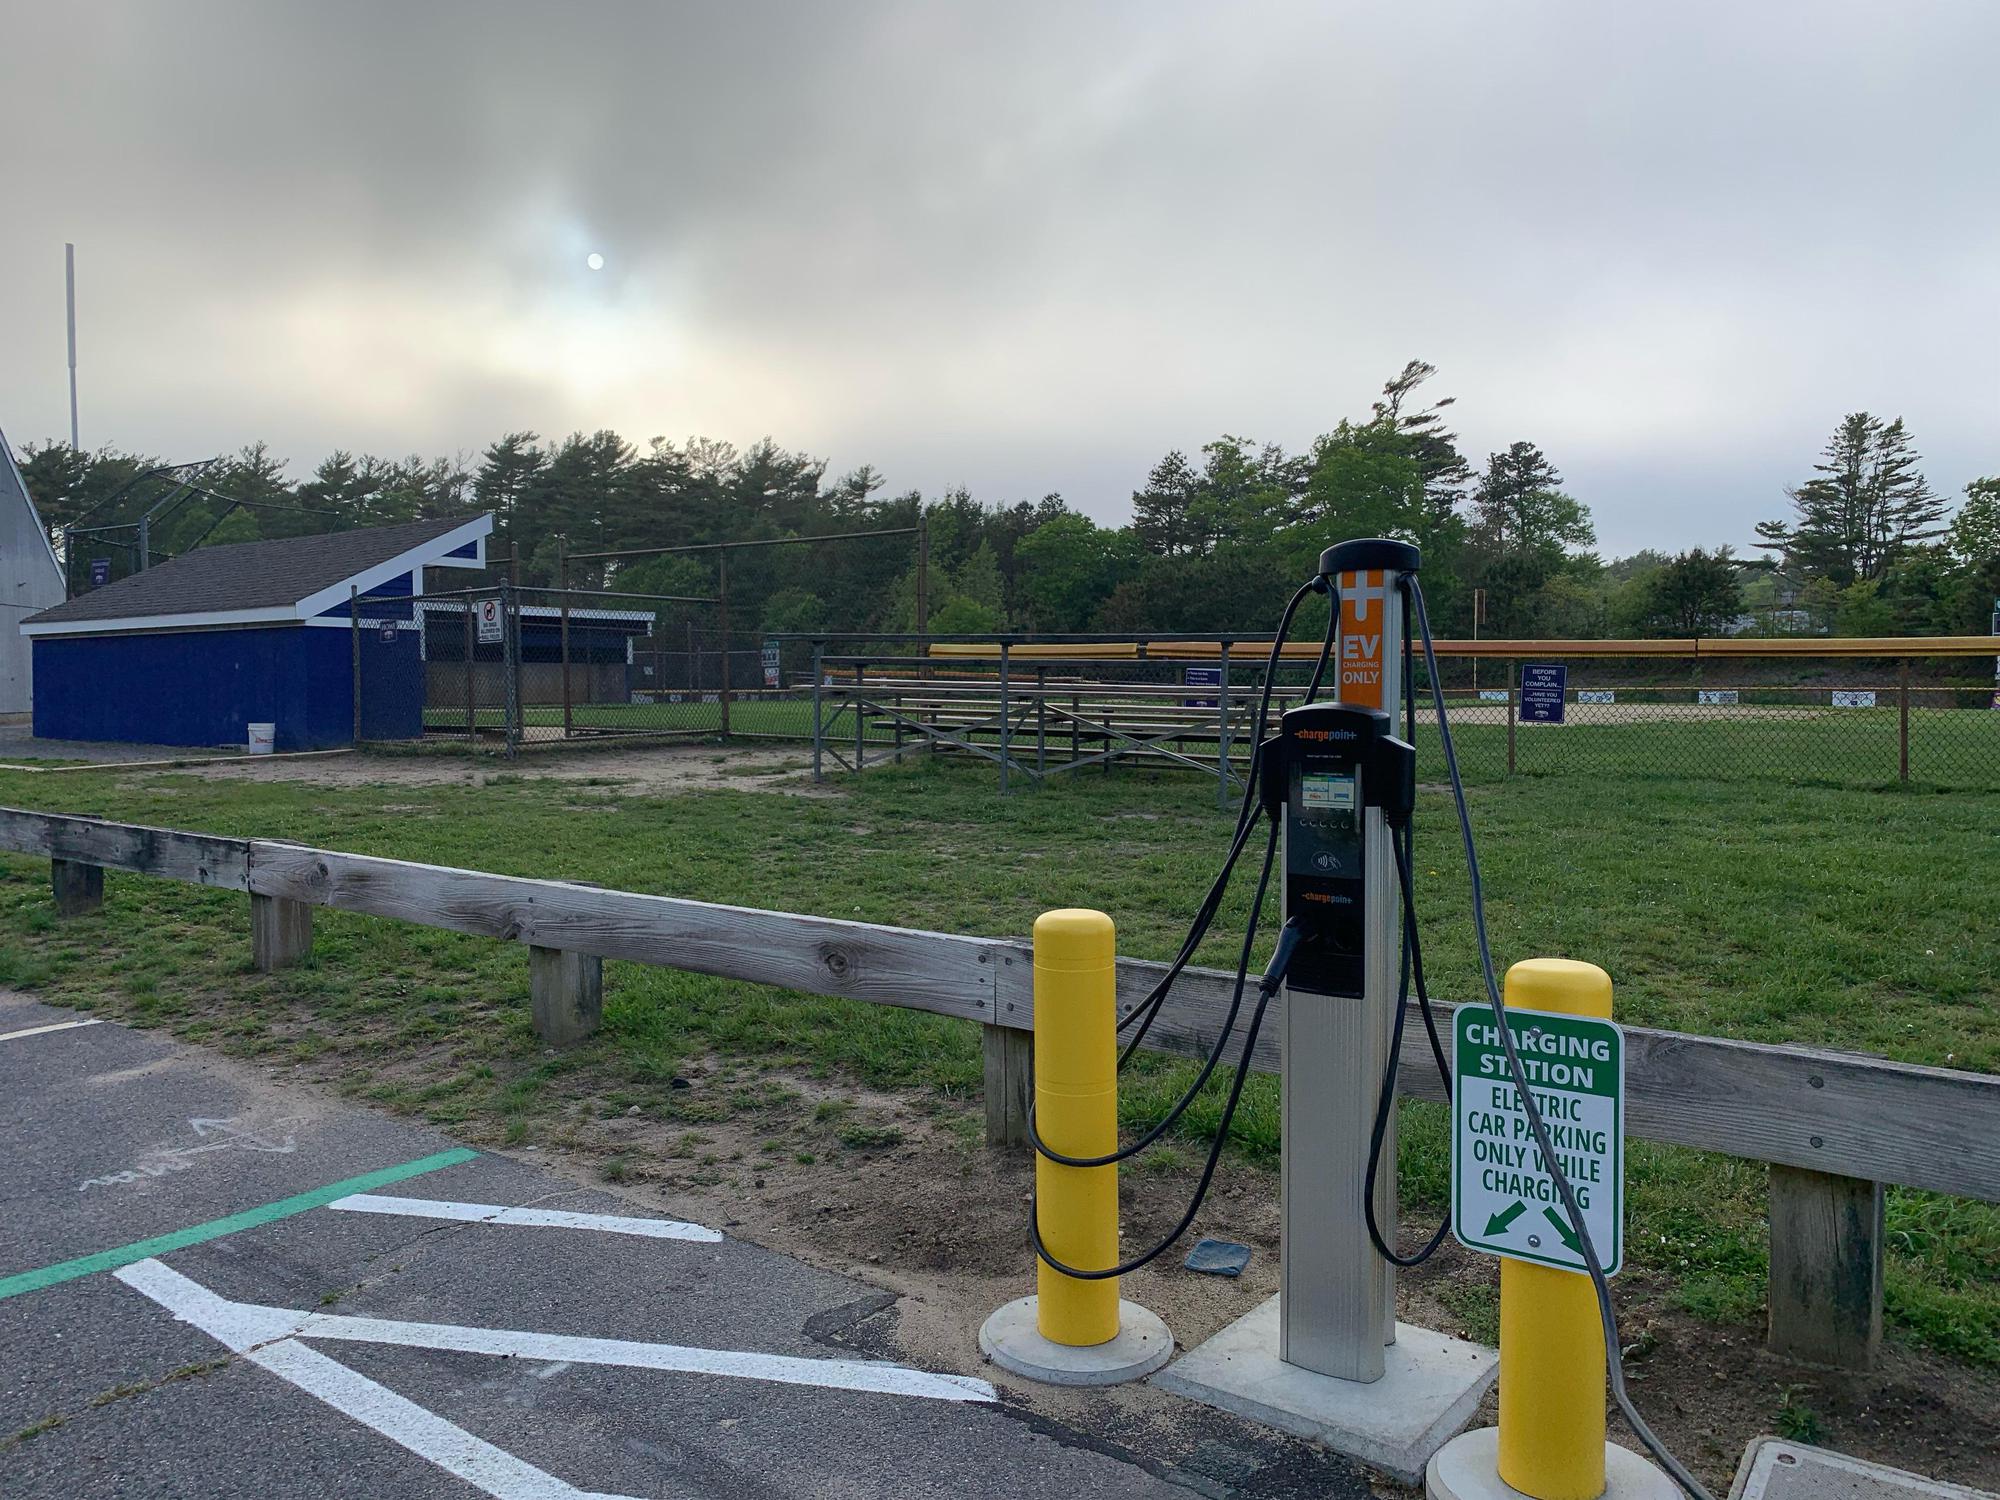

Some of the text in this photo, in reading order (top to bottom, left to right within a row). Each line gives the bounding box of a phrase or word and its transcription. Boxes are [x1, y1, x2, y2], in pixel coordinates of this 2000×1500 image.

[1343, 635, 1379, 659] EV
[1343, 671, 1379, 684] ONLY
[1491, 1086, 1582, 1122] ELETRIC
[1468, 1110, 1506, 1138] CAR
[1473, 1139, 1600, 1183] ONLY WHILE
